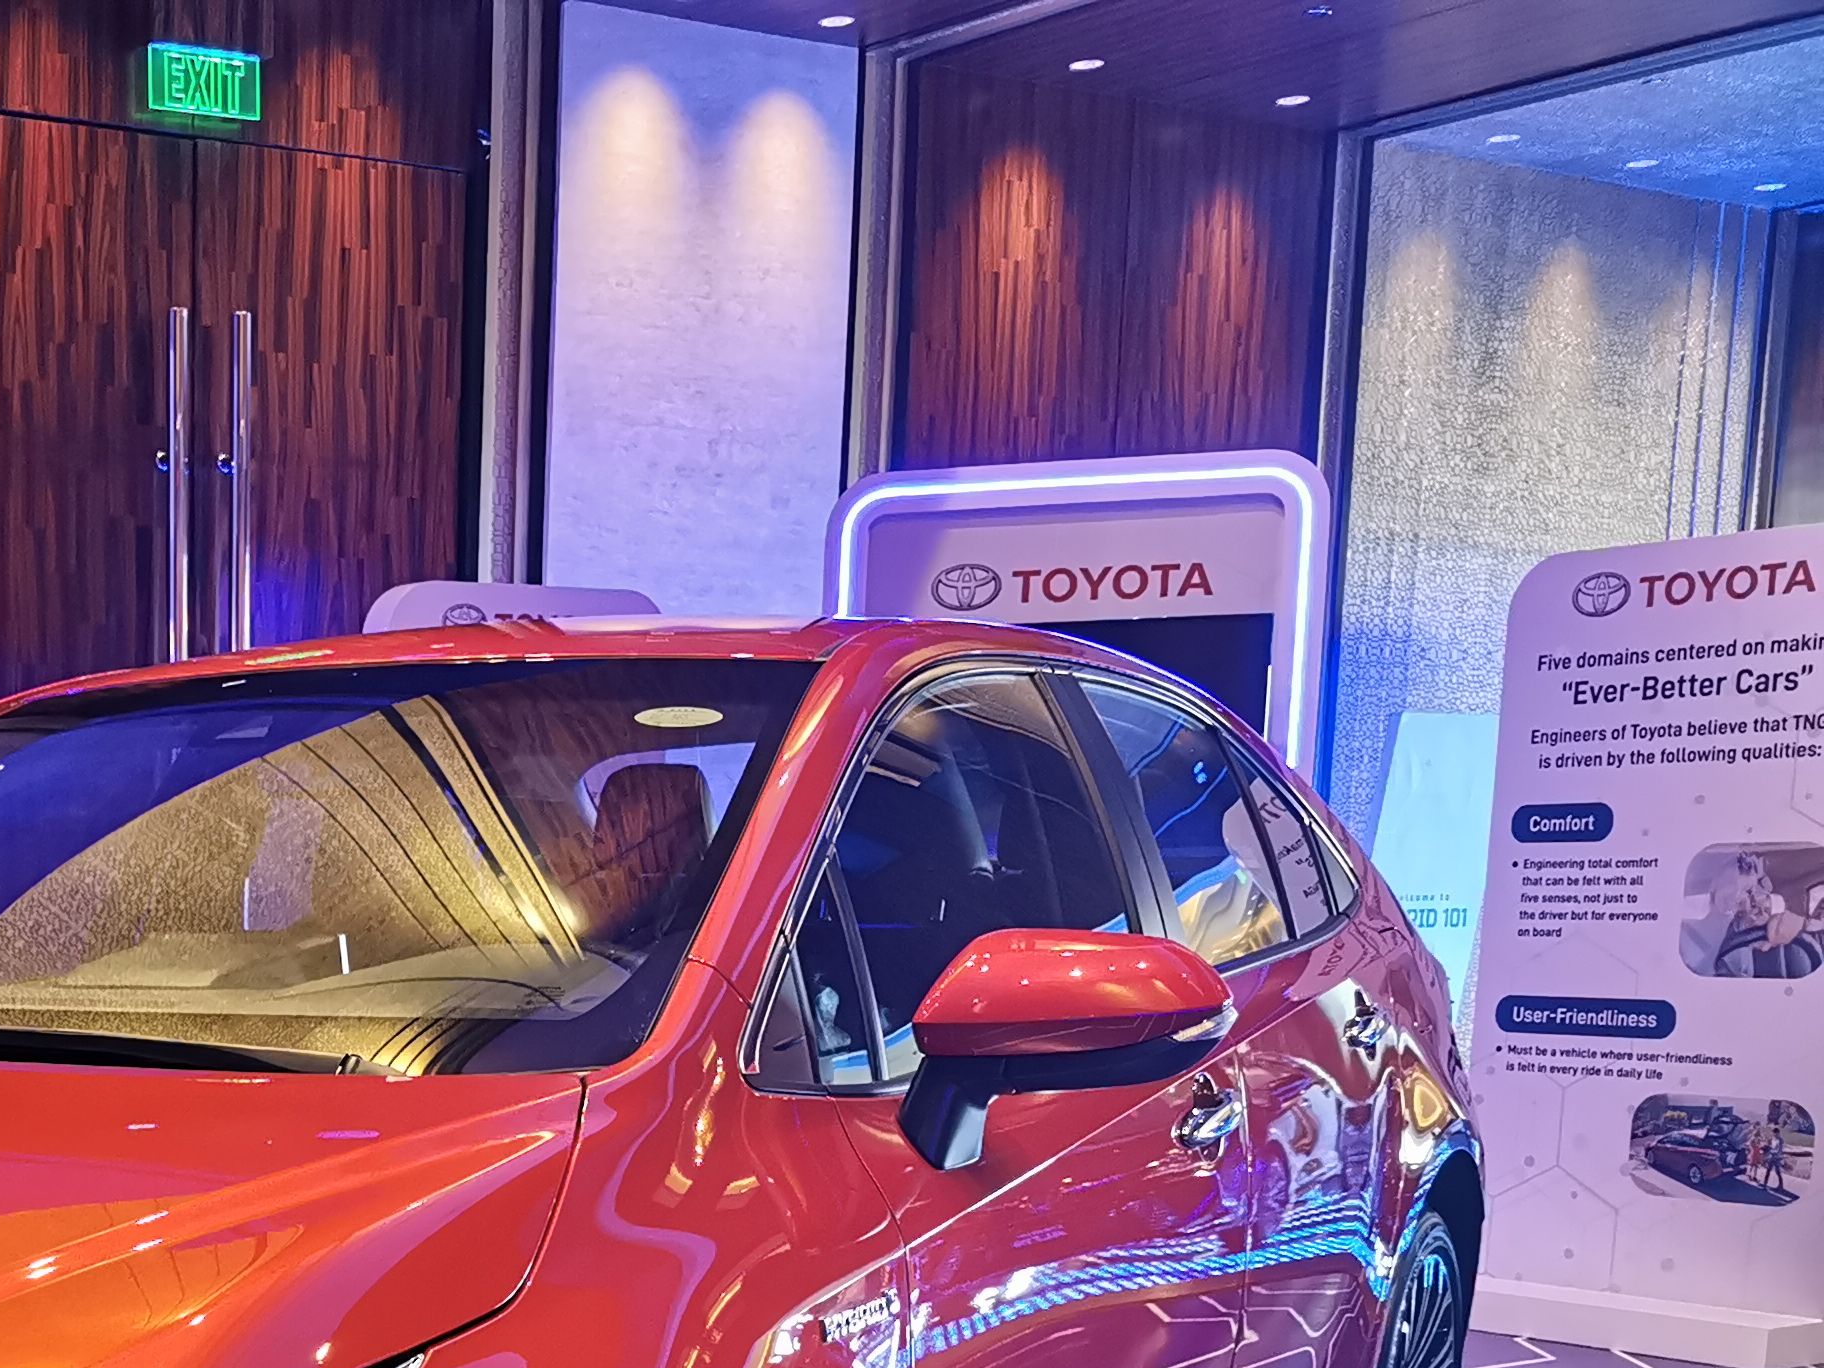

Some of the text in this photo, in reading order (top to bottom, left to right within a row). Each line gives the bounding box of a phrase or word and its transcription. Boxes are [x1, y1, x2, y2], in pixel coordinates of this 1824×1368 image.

[164, 51, 245, 114] EXIT
[1012, 562, 1213, 603] TOYOTA
[1639, 560, 1816, 608] TOYOTA
[1537, 632, 1824, 672] Five domains centered on maki
[1531, 713, 1824, 747] Engineers of Toyota believe that TNG
[1539, 741, 1822, 769] is driven by the following qualities:
[1529, 813, 1595, 834] Comfort
[1523, 857, 1658, 871] Engineering total comfort
[1522, 875, 1643, 886] that can be felt with all
[1520, 893, 1637, 905] five senses, not just to
[1443, 908, 1467, 927] 101
[1519, 910, 1658, 922] the driver but for everyone
[1517, 927, 1562, 937] on board
[1512, 1006, 1658, 1028] User-Friendliness
[1507, 1044, 1733, 1066] Must be a vehicle where user-friendliness
[1506, 1061, 1663, 1080] is felt in every ride in daily life
